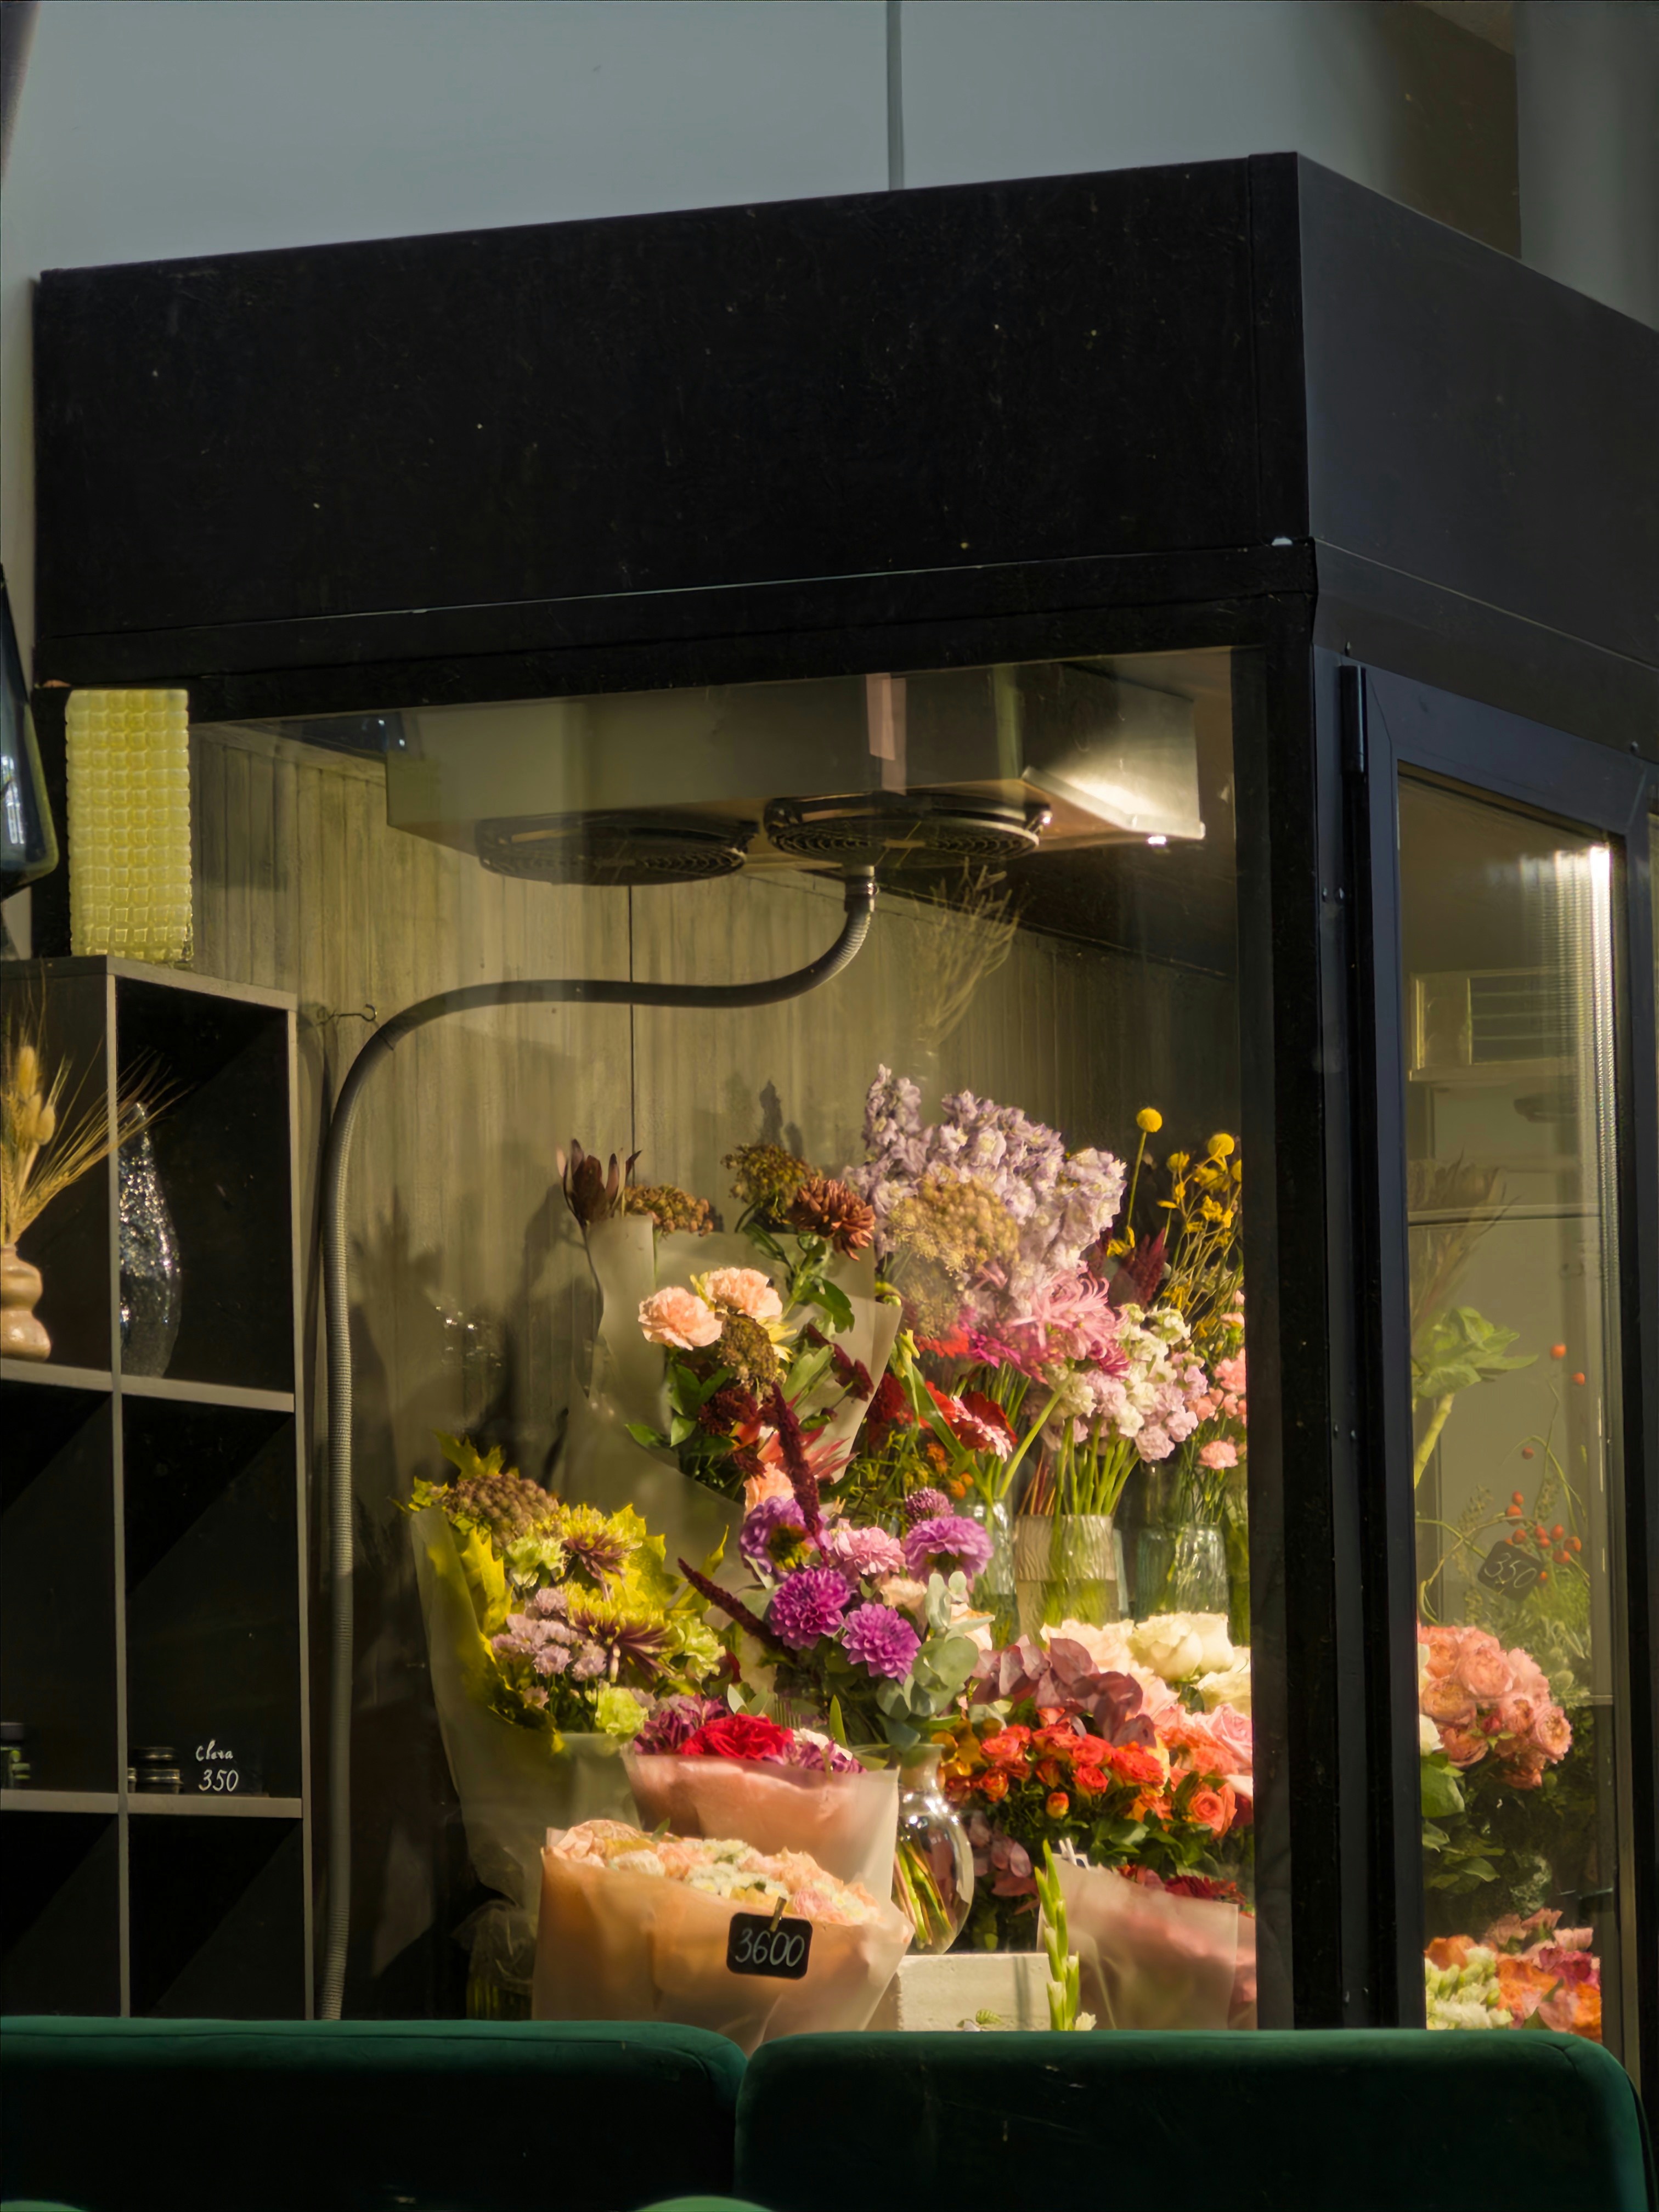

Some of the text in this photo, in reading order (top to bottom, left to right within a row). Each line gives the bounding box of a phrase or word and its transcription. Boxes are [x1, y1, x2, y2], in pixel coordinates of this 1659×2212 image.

[1484, 1553, 1537, 1589] 350
[199, 1769, 239, 1792] 350
[735, 1928, 805, 1967] 3600
